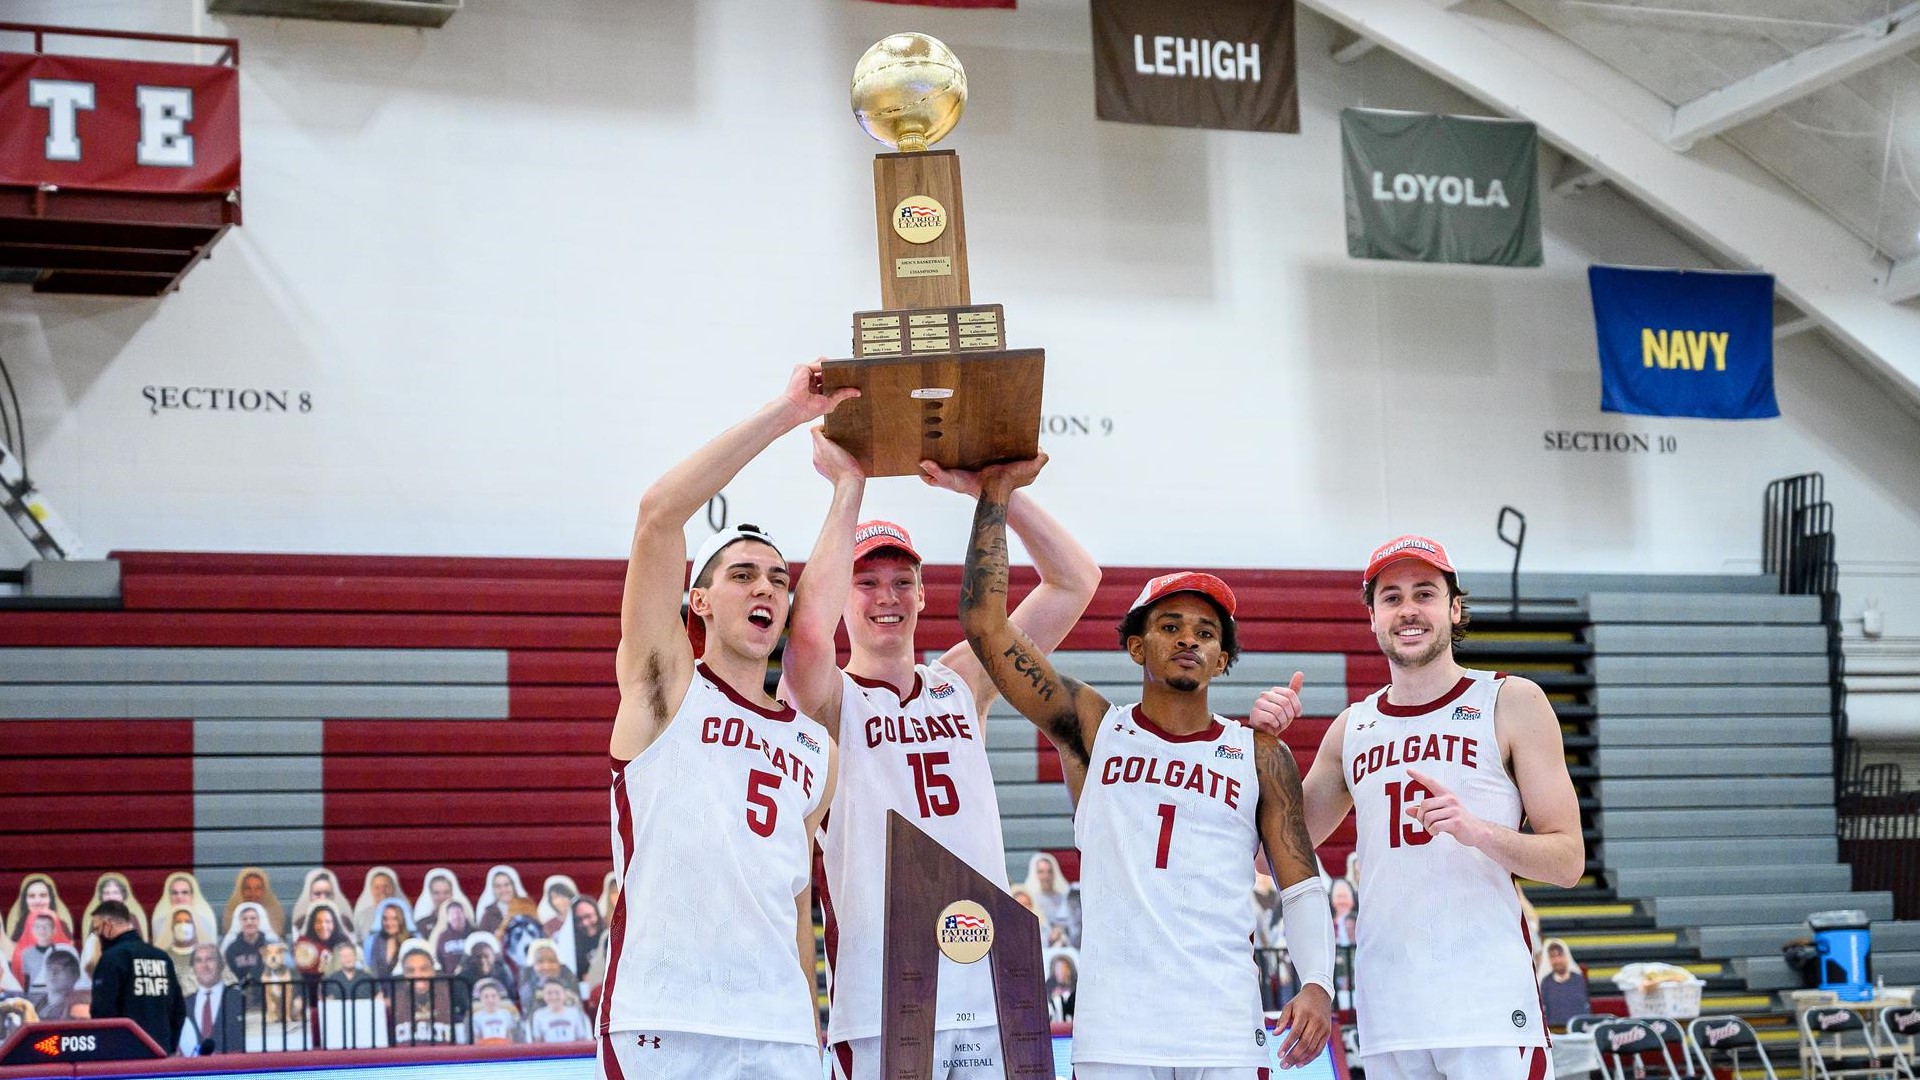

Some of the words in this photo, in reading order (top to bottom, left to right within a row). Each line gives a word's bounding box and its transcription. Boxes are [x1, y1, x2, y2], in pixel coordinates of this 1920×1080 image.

[1133, 33, 1262, 82] LEHIGH
[1372, 170, 1510, 209] LOYOLA
[898, 215, 942, 223] PATRIOT
[898, 221, 942, 229] LEAGUE
[1641, 326, 1730, 373] NAVY
[142, 384, 289, 414] SECTION
[298, 391, 313, 412] 8
[1101, 417, 1114, 436] 9
[1543, 429, 1650, 453] SECTION
[1657, 433, 1677, 454] 10
[854, 523, 907, 545] HAMPIONS
[1376, 538, 1437, 561] CHAMPIONS
[865, 712, 974, 749] COLGATE
[701, 716, 814, 800] COLGATE
[1352, 733, 1479, 786] COLGATE
[906, 751, 960, 818] 15
[1101, 755, 1242, 811] COLGATE
[746, 768, 783, 838] 5
[1385, 779, 1435, 849] 13
[1155, 803, 1177, 870] 1
[941, 928, 990, 936] PATRIOT
[941, 935, 990, 943] LEAGUE
[133, 956, 167, 979] EVENT
[132, 976, 169, 997] STAFF
[956, 1013, 976, 1022] 2021
[60, 1034, 96, 1054] POSS
[954, 1043, 981, 1053] MEN'S
[942, 1058, 994, 1069] BASKETBALL
